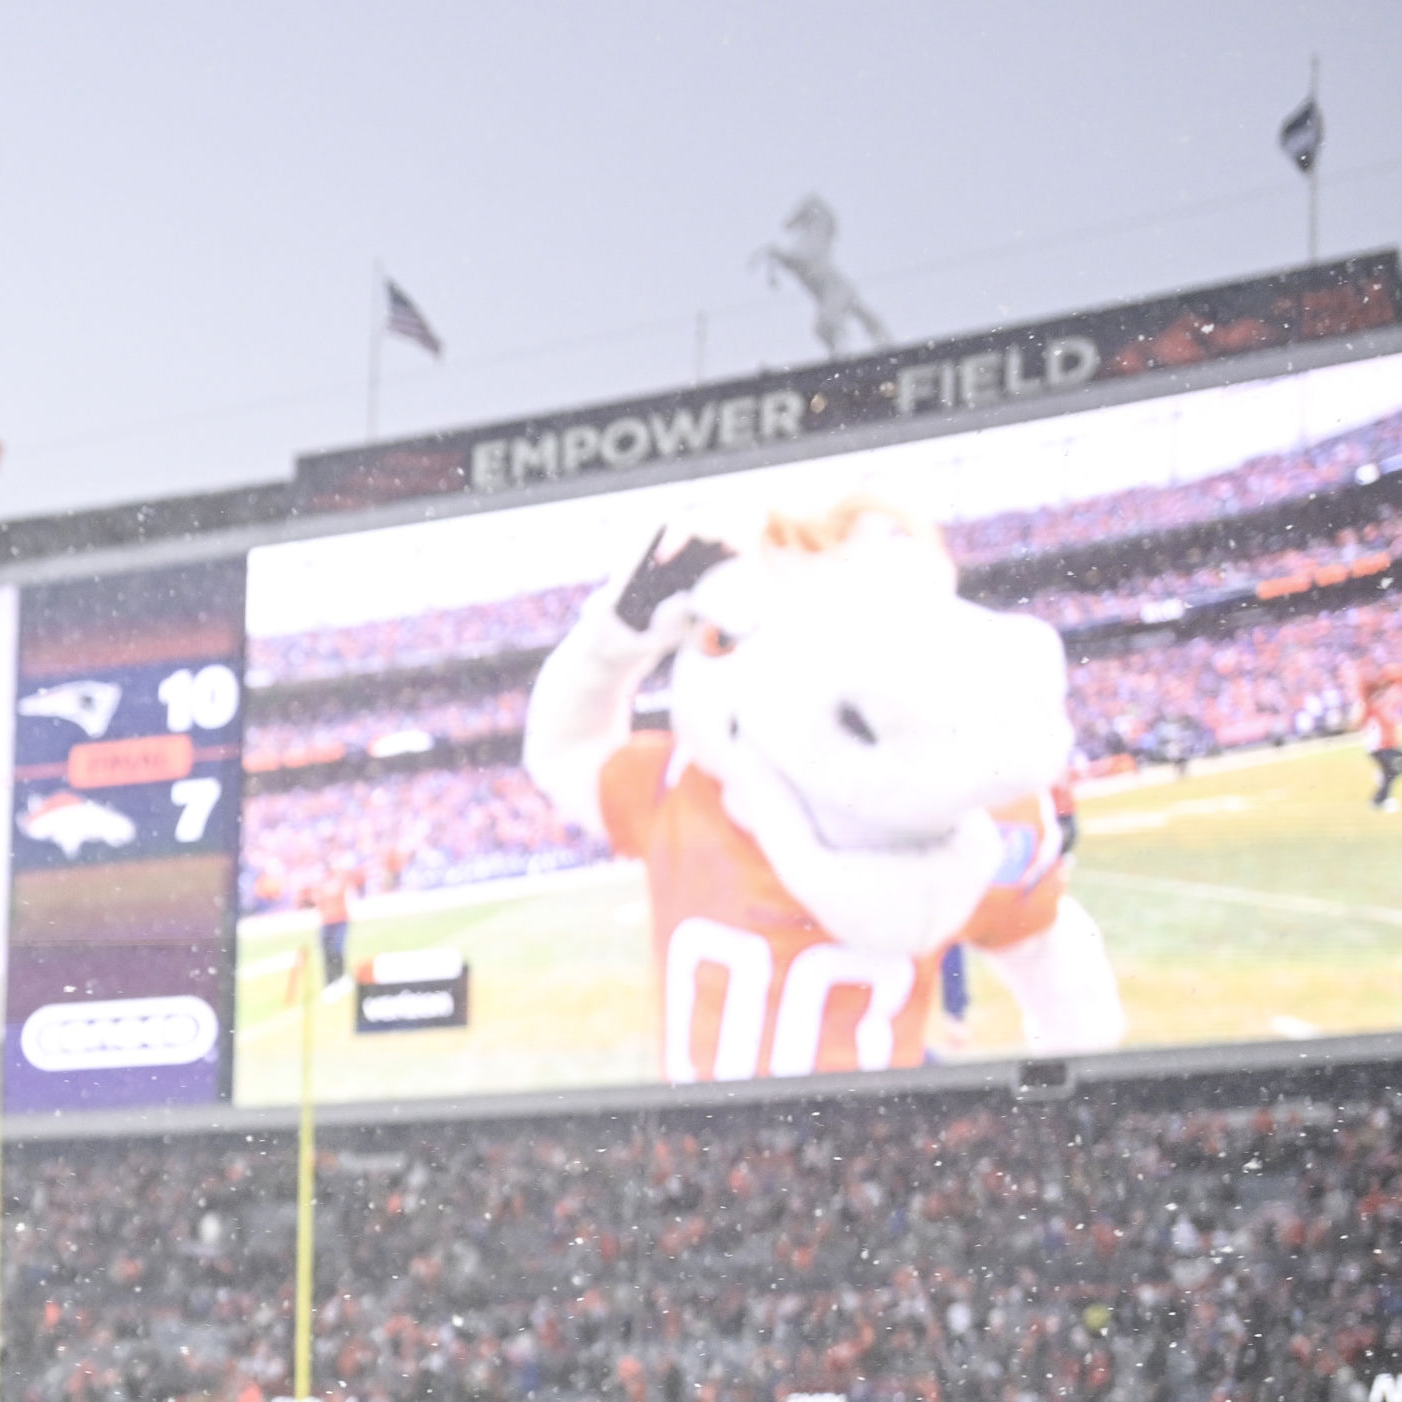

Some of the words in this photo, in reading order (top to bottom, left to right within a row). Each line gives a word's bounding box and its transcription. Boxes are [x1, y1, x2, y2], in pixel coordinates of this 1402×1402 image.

[471, 394, 802, 489] EMPOWER
[896, 336, 1098, 416] FIELD
[158, 664, 240, 732] 10
[170, 777, 222, 842] 7
